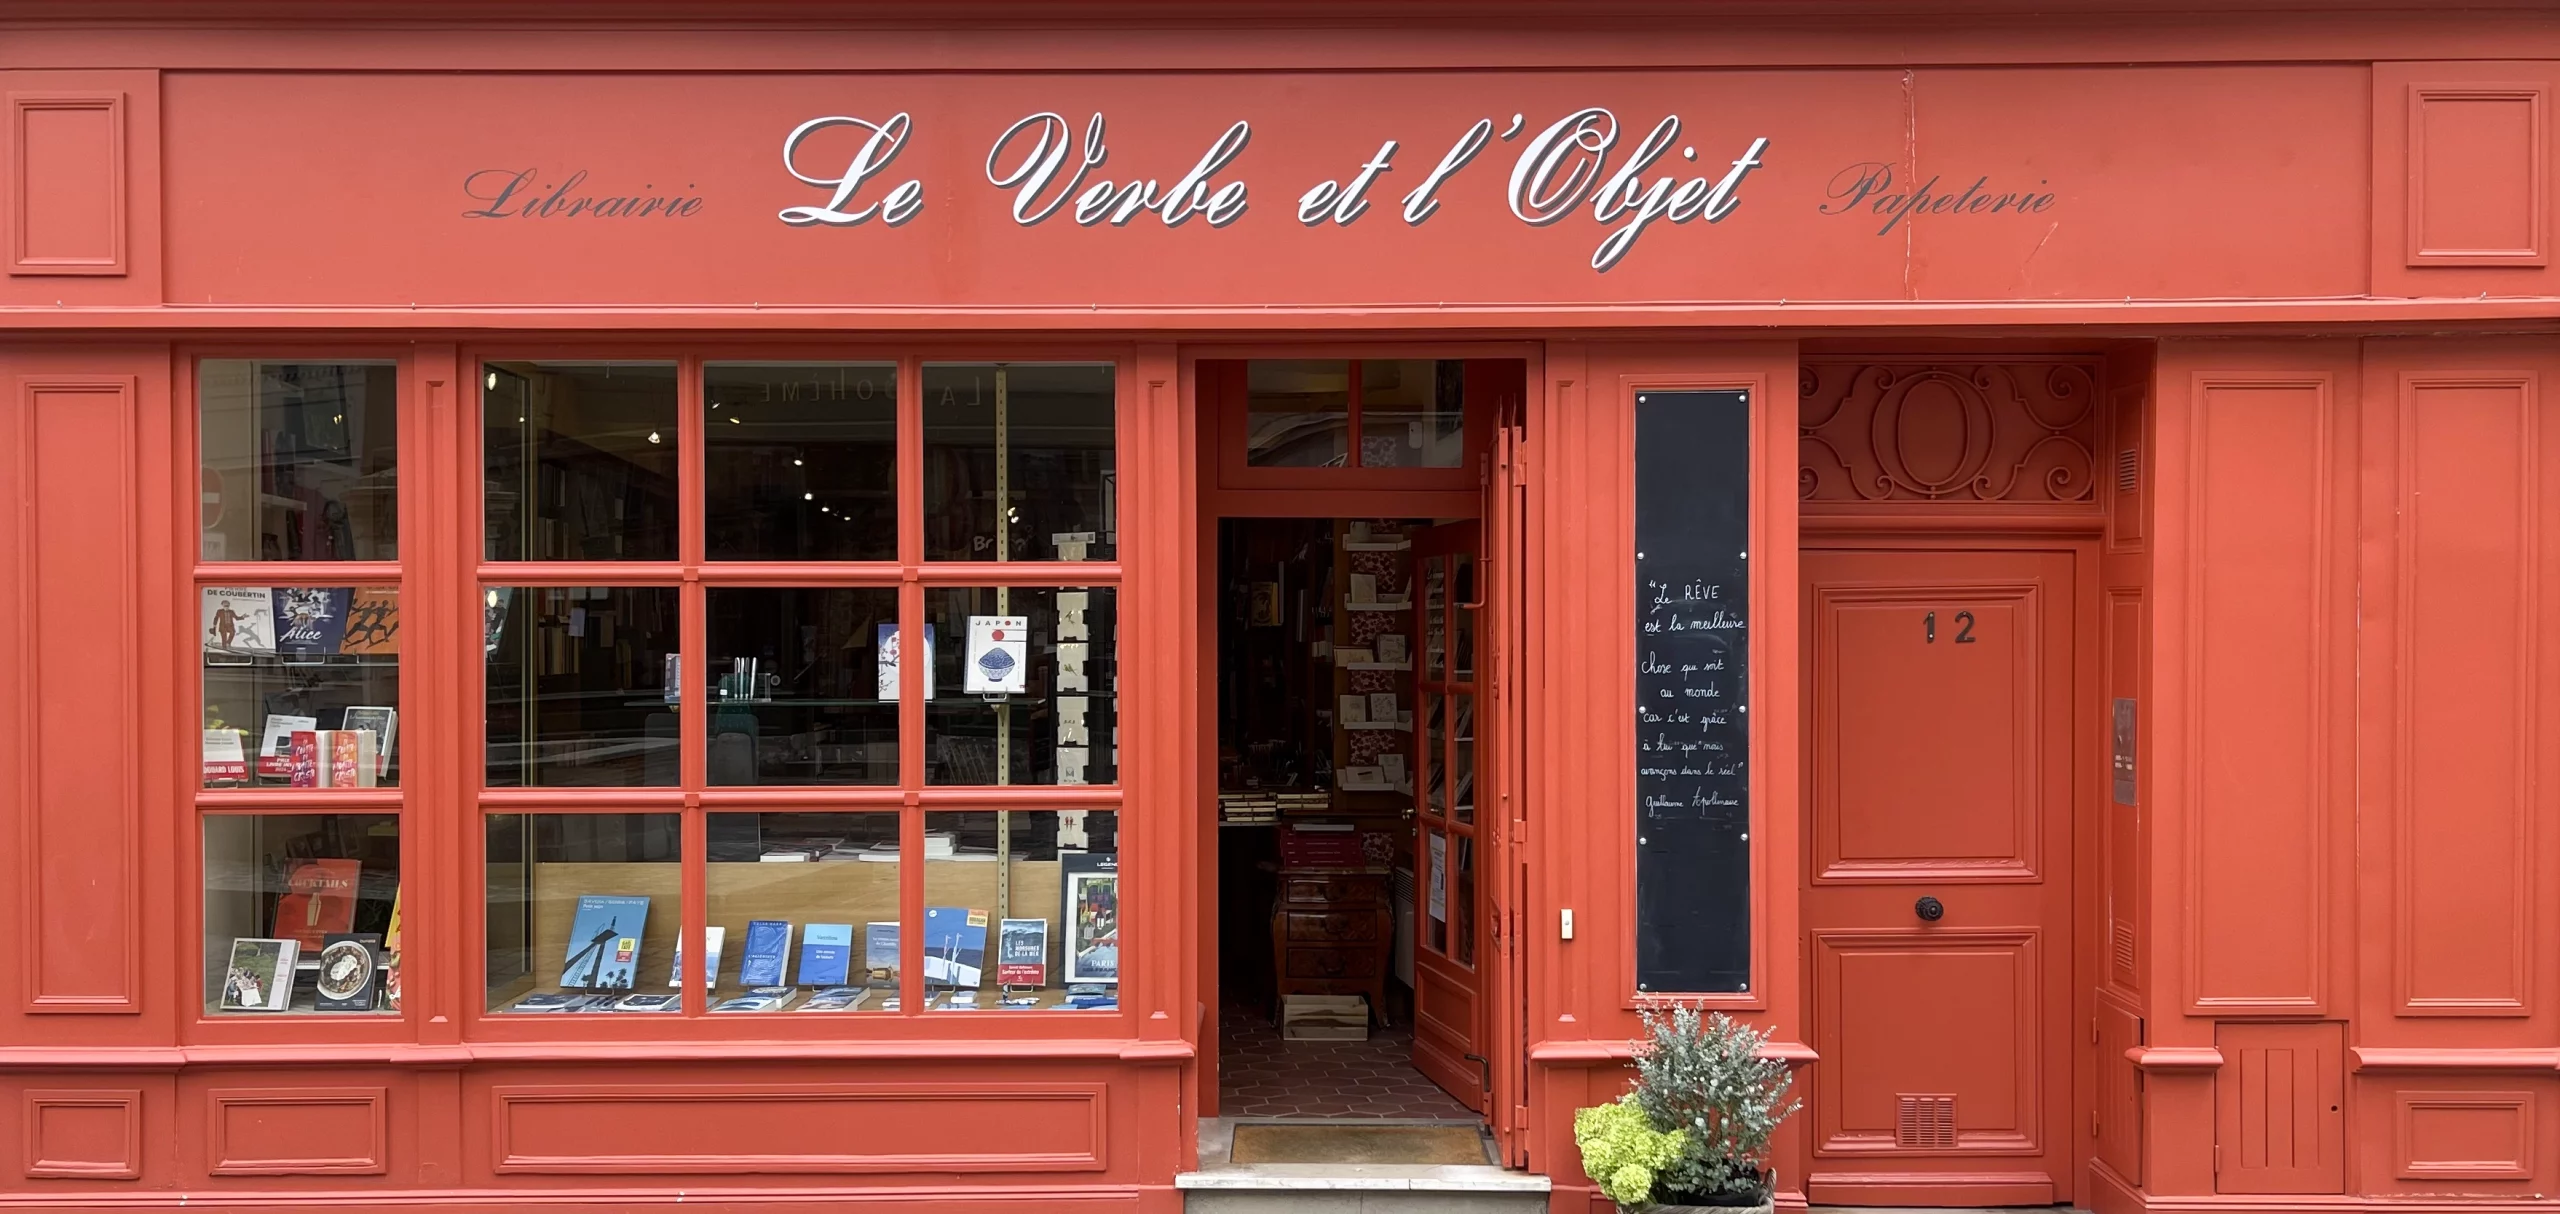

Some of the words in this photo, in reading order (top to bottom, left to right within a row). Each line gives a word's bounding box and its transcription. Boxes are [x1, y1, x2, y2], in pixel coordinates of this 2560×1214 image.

[462, 167, 703, 219] Librairie
[778, 111, 925, 227] Le
[985, 111, 1252, 228] Verbe
[1298, 140, 1400, 228] et
[1402, 107, 1770, 274] l'Objet
[1818, 161, 2057, 237] Papeterie
[219, 590, 266, 599] COUBERTIN
[1684, 579, 1720, 601] RÊVE
[1644, 618, 1661, 633] est
[1668, 611, 1685, 631] la
[1690, 611, 1746, 630] meilleure
[1923, 610, 1977, 644] 12
[279, 627, 322, 642] Alice
[1680, 663, 1698, 682] qui
[1703, 659, 1725, 672] soit
[1660, 687, 1674, 697] au
[1684, 681, 1720, 697] monde
[1643, 713, 1662, 723] car
[1667, 708, 1690, 723] c'est
[1700, 711, 1728, 732] grâce
[1642, 739, 1651, 751] à
[1681, 742, 1699, 758] que
[1703, 742, 1724, 751] nous
[204, 765, 227, 774] DOUARD
[227, 765, 245, 774] LOUIS
[1640, 766, 1678, 781] avançons
[1680, 764, 1702, 776] dans
[1705, 761, 1715, 776] le
[1692, 786, 1740, 815] Apollinaire
[288, 878, 349, 889] COCKTAILS
[1091, 959, 1115, 967] PARIS
